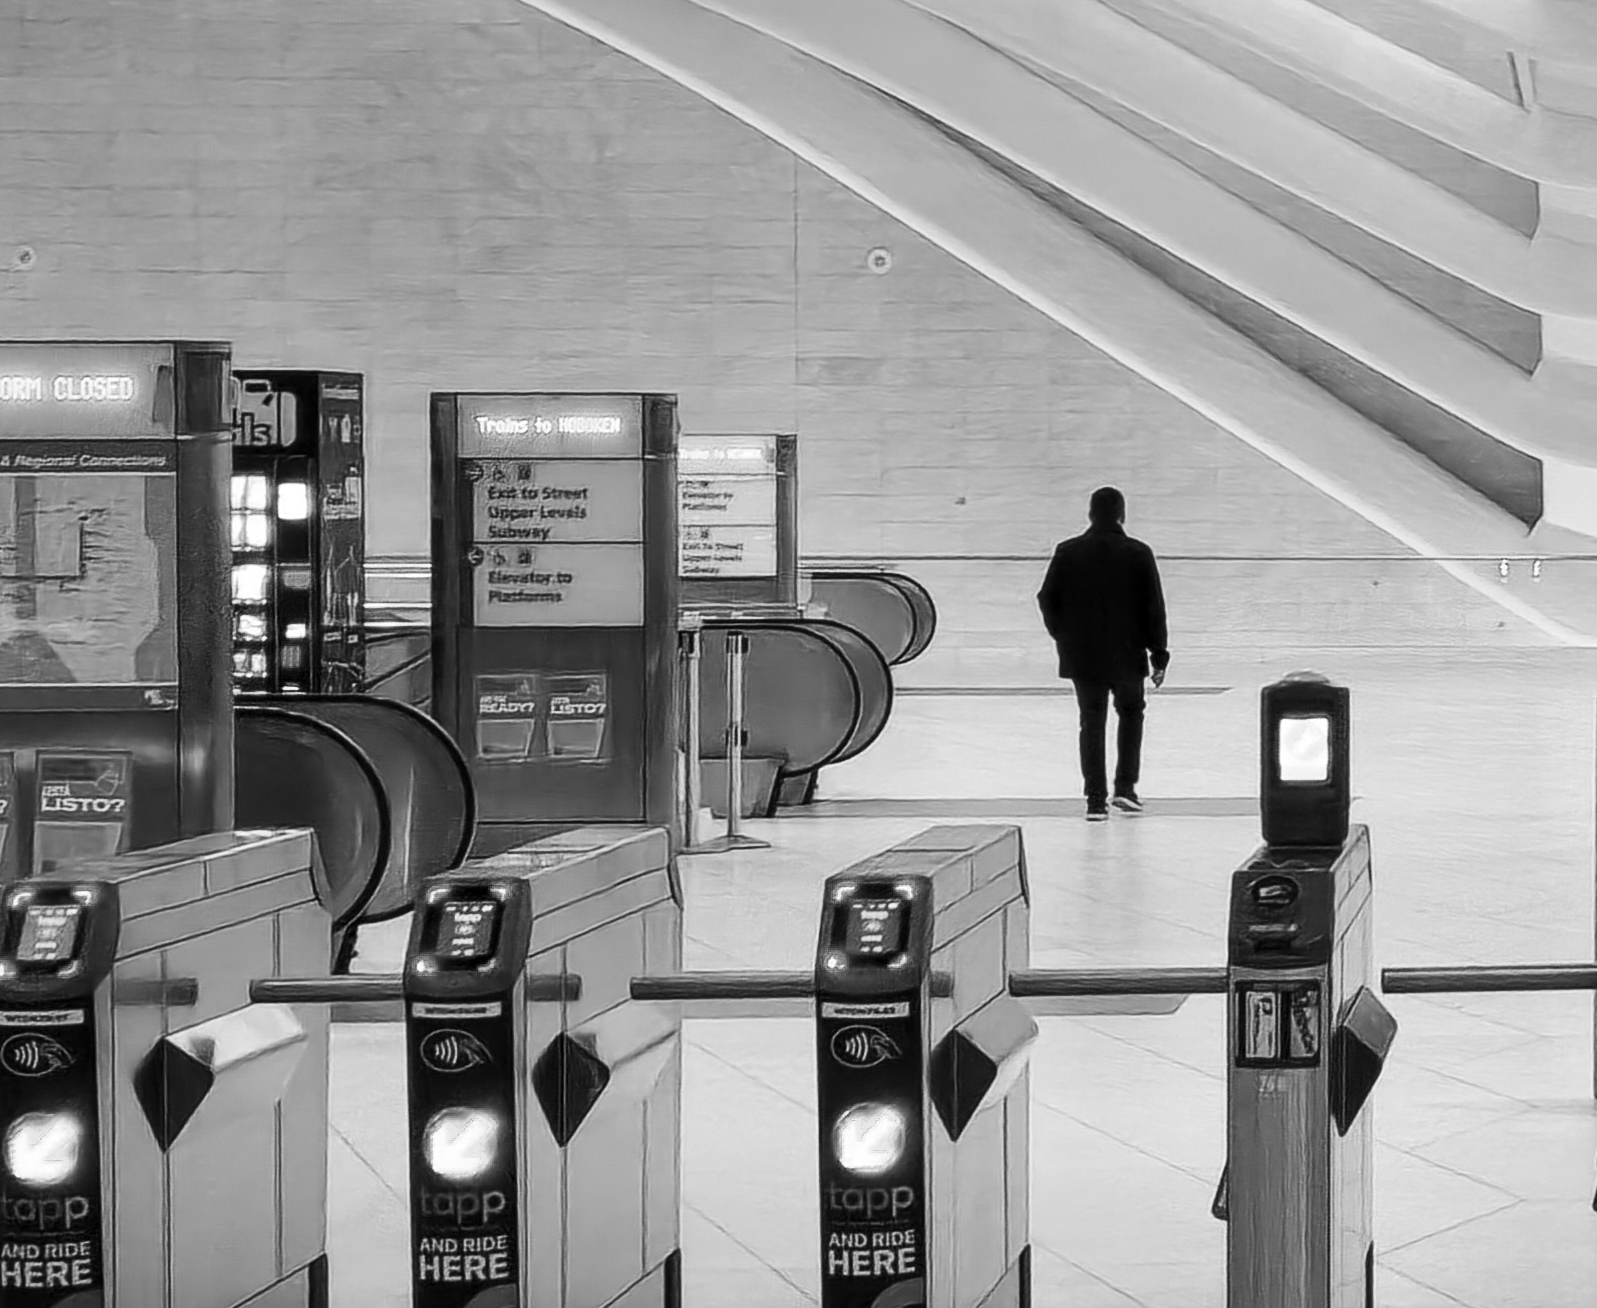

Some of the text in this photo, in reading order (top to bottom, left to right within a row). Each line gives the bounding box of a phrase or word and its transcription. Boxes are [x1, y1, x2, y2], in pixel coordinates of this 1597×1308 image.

[54, 377, 134, 401] CLOSED
[477, 416, 621, 434] Trains to HOBOKEN
[13, 455, 77, 469] Regional
[79, 455, 167, 467] Connections
[488, 486, 588, 500] Exit to Street
[488, 505, 587, 522] Upper Levels
[488, 525, 550, 541] Subway
[556, 571, 573, 585] to
[479, 702, 535, 714] READY?
[550, 703, 607, 715] LISTO?
[41, 797, 125, 813] LISTO?
[422, 1187, 506, 1225] tapp
[829, 1181, 915, 1219] tapp
[1, 1193, 89, 1230] tapp
[420, 1234, 508, 1253] AND RIDE
[828, 1229, 916, 1248] AND RIDE
[1, 1240, 91, 1259] AND RIDE
[420, 1252, 509, 1281] HERE
[828, 1247, 916, 1276] HERE
[1, 1259, 93, 1288] HERE
